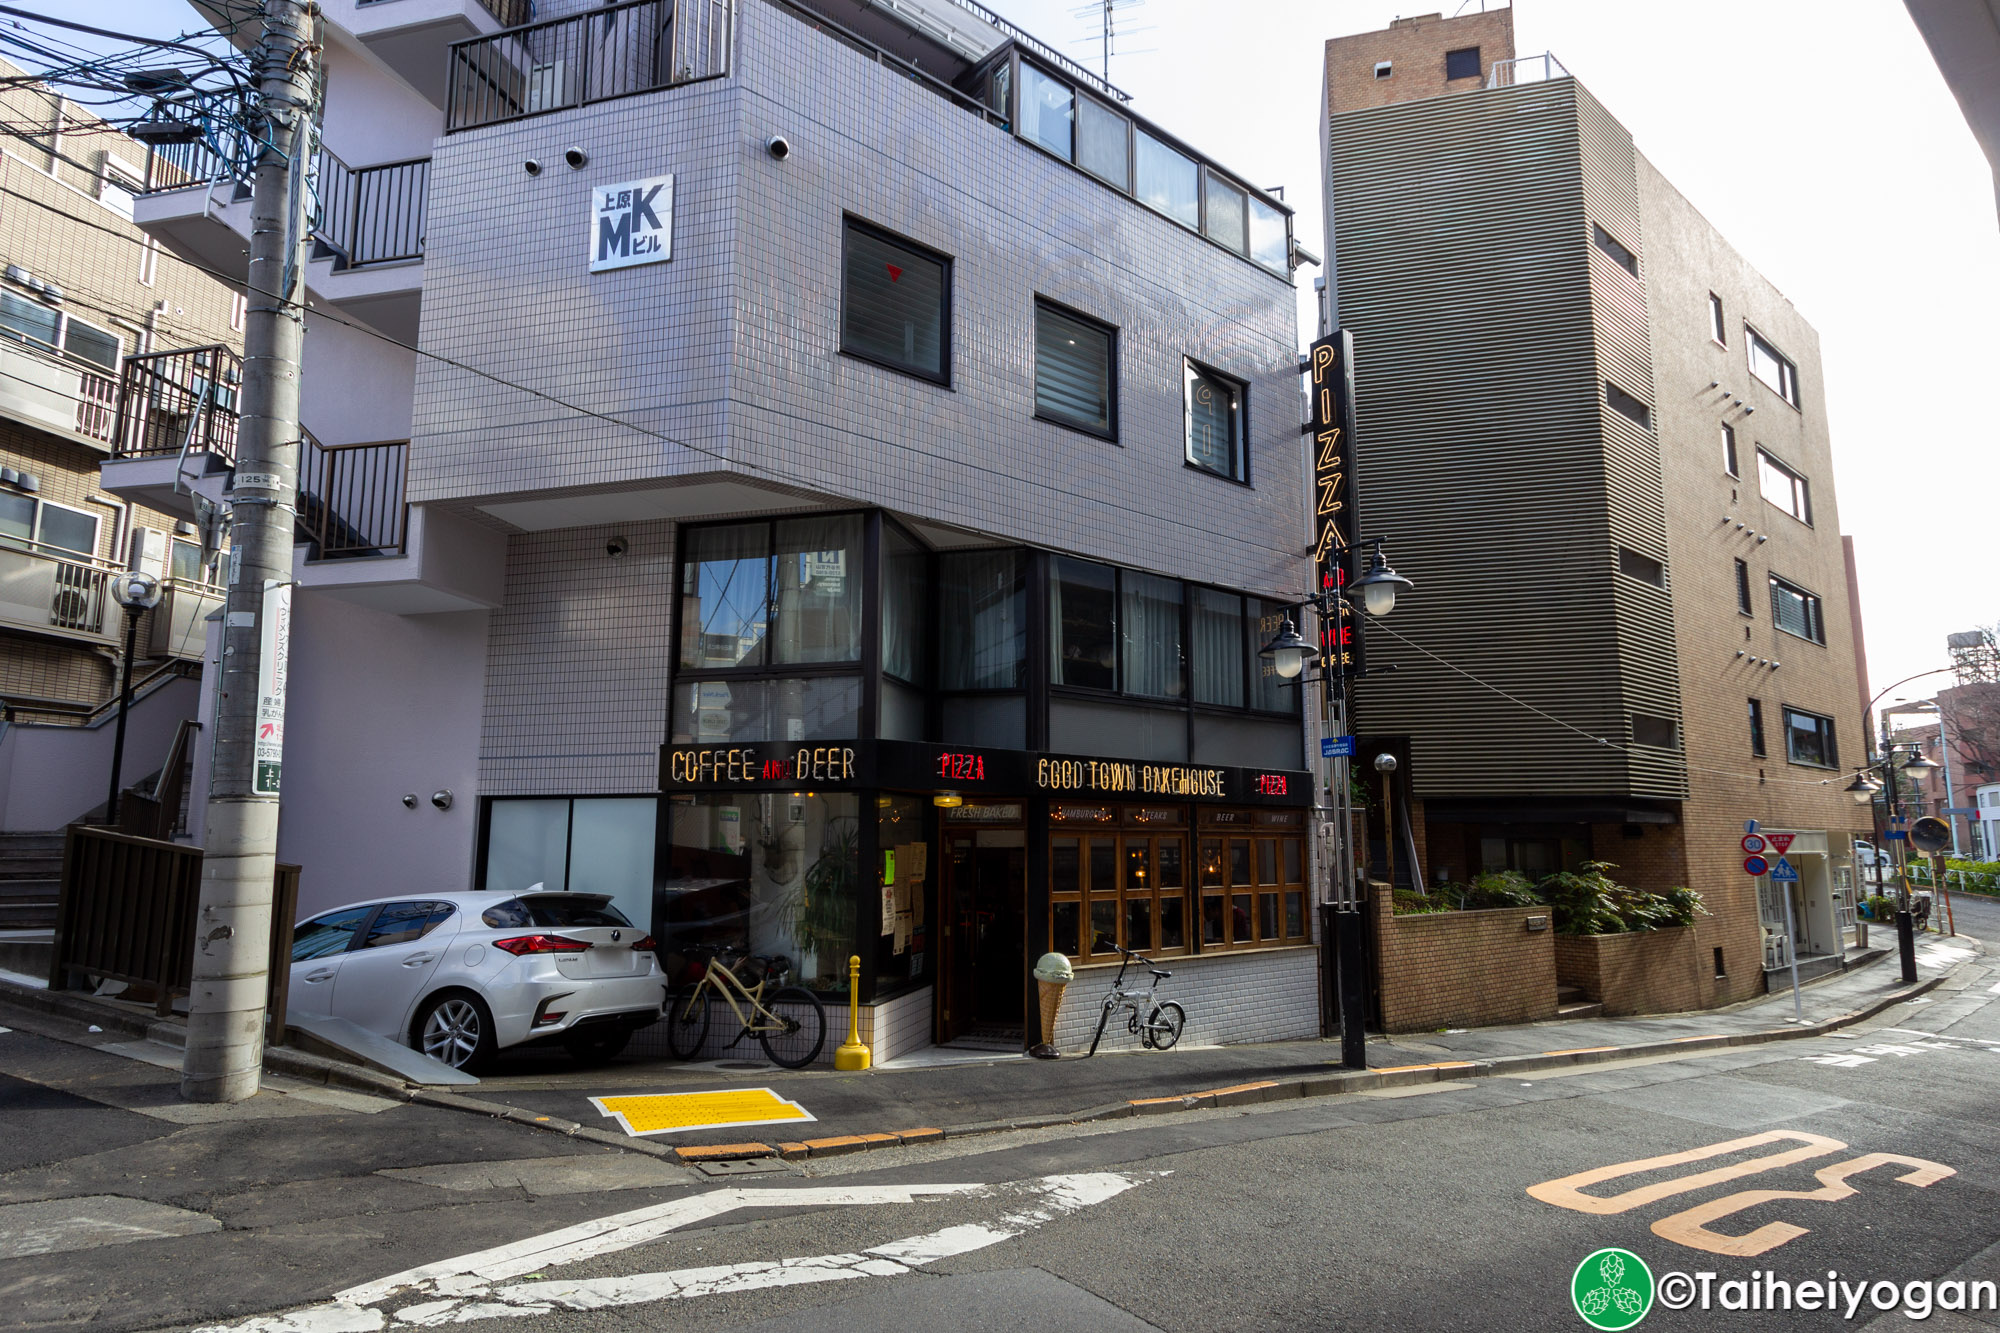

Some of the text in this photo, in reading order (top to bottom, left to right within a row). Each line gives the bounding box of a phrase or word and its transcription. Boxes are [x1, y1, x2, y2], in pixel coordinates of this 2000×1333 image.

[600, 190, 632, 212] 上原
[633, 235, 661, 255] ビル
[1313, 344, 1348, 563] PIZZA
[241, 475, 261, 483] 125
[275, 607, 286, 696] ウィメンズクリニック
[672, 748, 855, 783] COFFEE AND BEER
[942, 752, 985, 780] PIZZA
[1038, 758, 1226, 797] GOOD TOWN BAKEHOUSE
[1260, 774, 1288, 796] PIZZA
[950, 806, 1016, 819] FRESH BAKED
[1060, 808, 1107, 820] HAMBURGERS
[1141, 810, 1168, 820] STEAKS
[1216, 813, 1235, 822] BEER
[1271, 814, 1289, 823] WINE
[1746, 840, 1761, 849] 30
